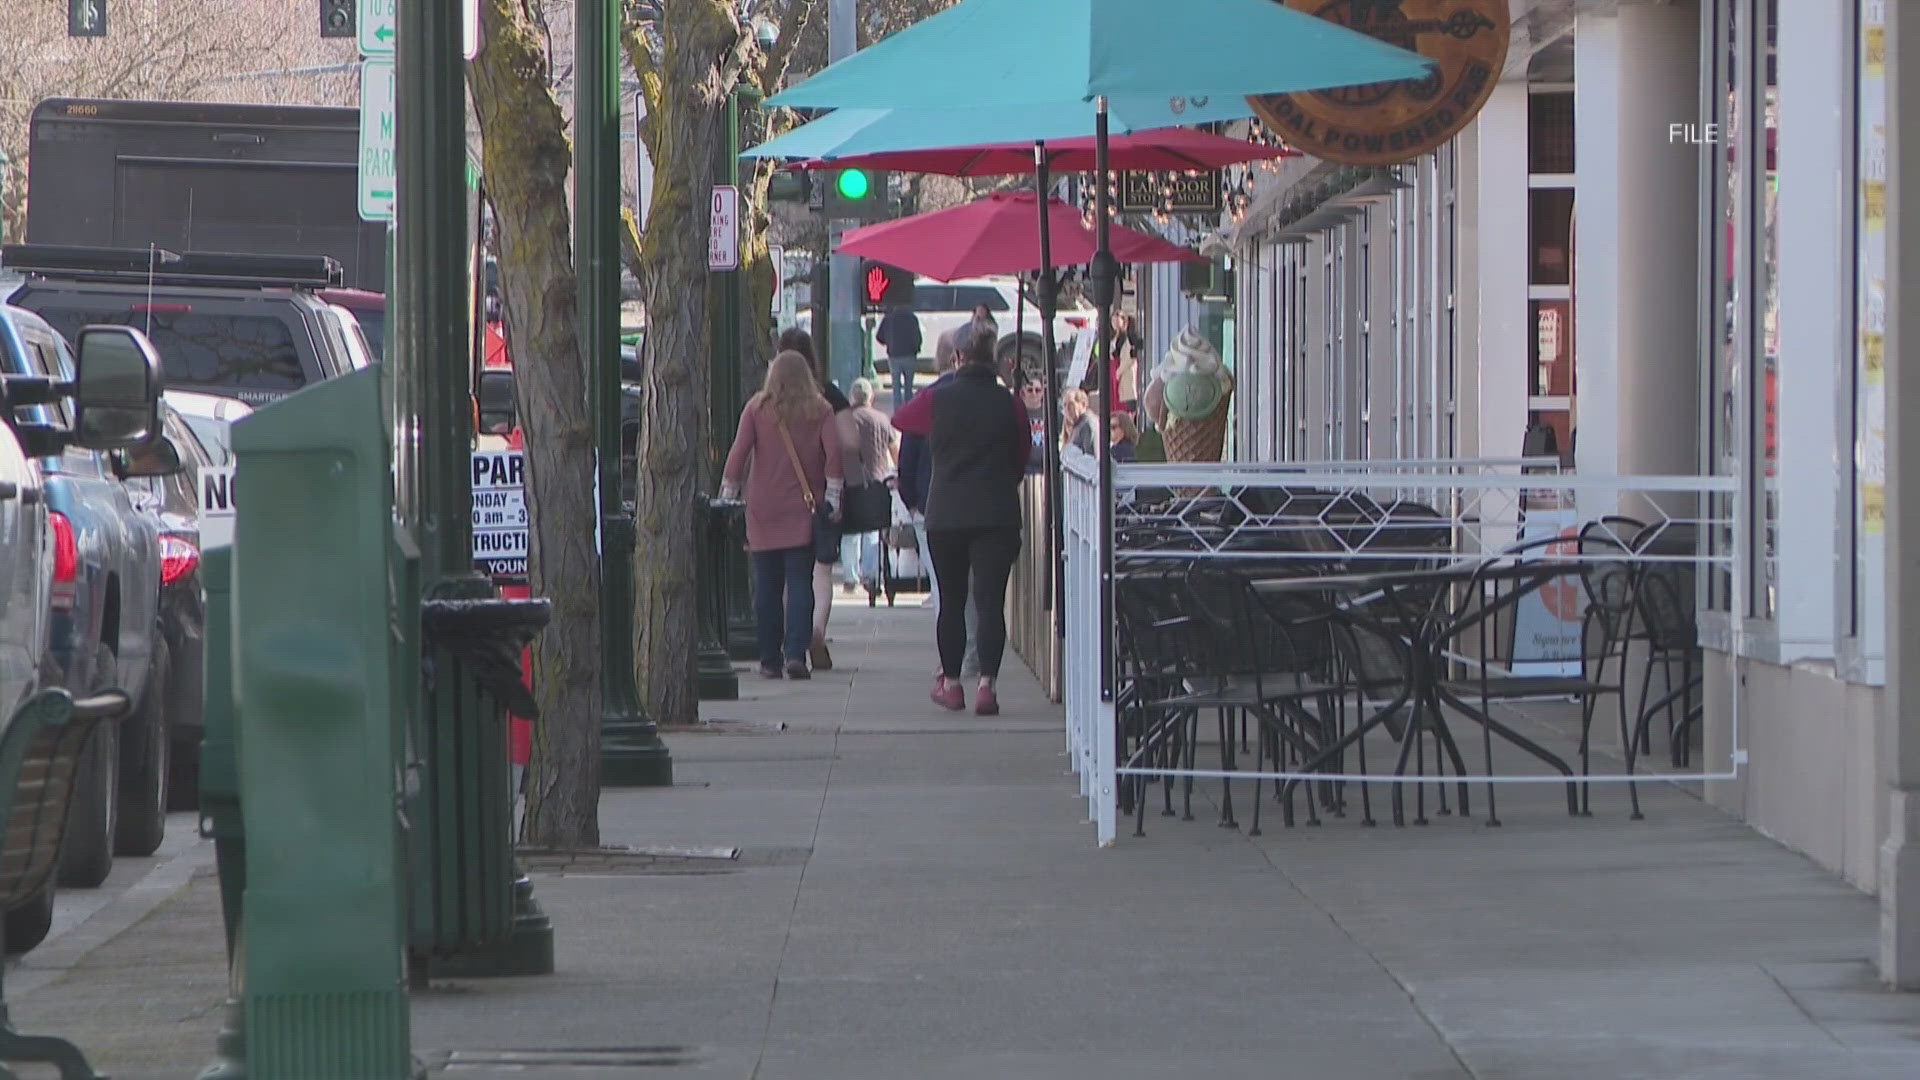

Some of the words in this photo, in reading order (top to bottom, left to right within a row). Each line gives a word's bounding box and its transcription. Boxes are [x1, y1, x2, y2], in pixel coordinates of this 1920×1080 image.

[366, 147, 395, 176] PAR
[473, 455, 523, 486] PAR
[205, 474, 235, 510] N
[472, 493, 507, 508] NDAY
[485, 511, 503, 524] am
